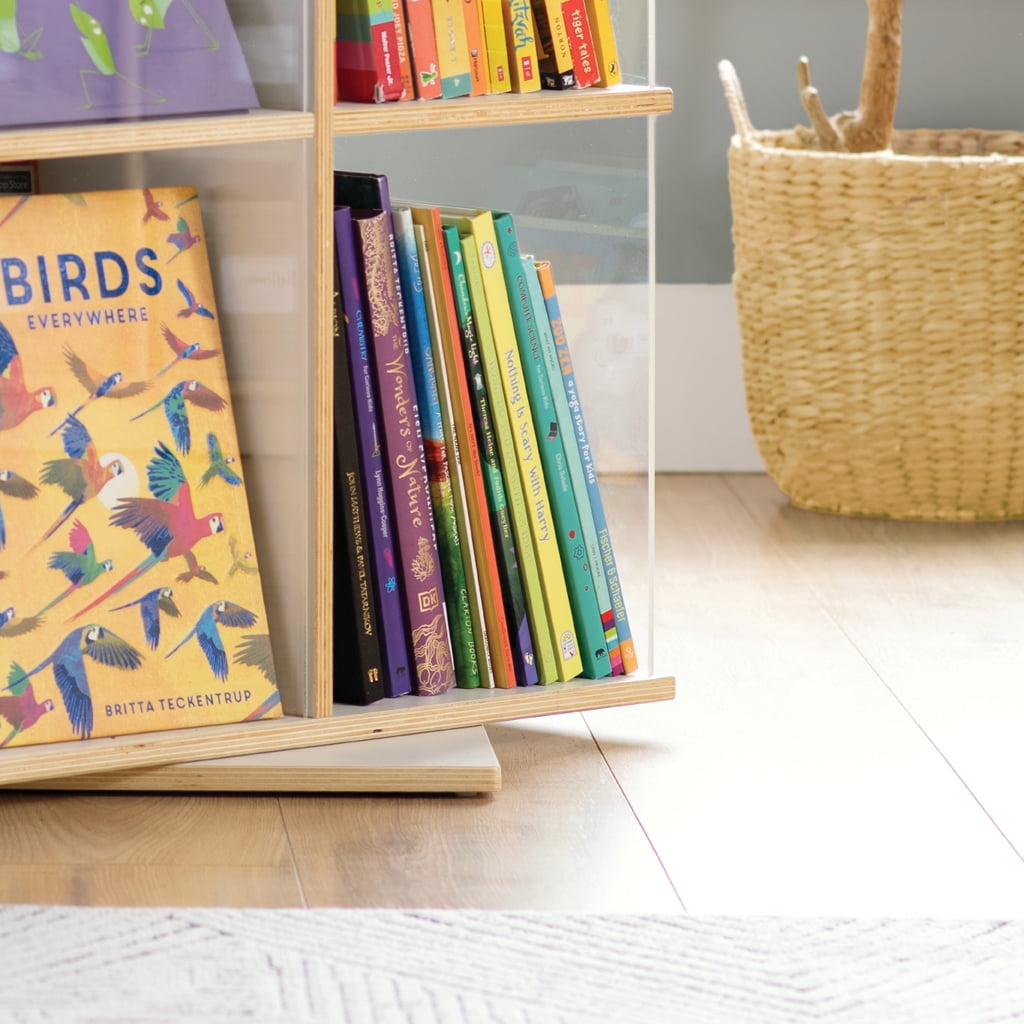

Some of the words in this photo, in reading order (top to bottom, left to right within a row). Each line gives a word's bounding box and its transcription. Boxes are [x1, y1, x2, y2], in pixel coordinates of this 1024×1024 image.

[392, 10, 404, 34] JOEY
[571, 8, 586, 40] tiger
[555, 17, 566, 58] NORTON
[578, 44, 592, 73] tales
[0, 247, 164, 306] BIRDS
[27, 306, 150, 331] EVERYWHERE
[461, 316, 475, 343] Magic
[518, 275, 532, 323] COMPUTER
[526, 325, 540, 361] SCIENCE
[391, 335, 400, 350] THE
[551, 318, 567, 348] ZOO
[467, 343, 480, 366] Light
[557, 348, 573, 376] ZEN
[505, 350, 522, 404] Nothing
[567, 380, 574, 388] a
[386, 353, 412, 436] Wonders
[566, 388, 580, 413] yoga
[479, 398, 491, 431] Theresa
[485, 432, 495, 456] Heine
[515, 406, 526, 419] Is
[519, 422, 533, 462] Scary
[573, 412, 588, 444] story
[405, 440, 413, 452] OF
[581, 444, 592, 460] for
[373, 470, 384, 486] Lynn
[529, 466, 542, 496] With
[585, 463, 597, 485] kids
[396, 452, 422, 529] Nature
[536, 500, 550, 542] Harry
[598, 528, 615, 568] Fischer
[608, 576, 627, 623] Schaefer
[460, 589, 473, 634] CLARION
[468, 641, 478, 675] BOOKS
[105, 700, 154, 718] BRITTA
[158, 690, 252, 711] TECKENTRUP
